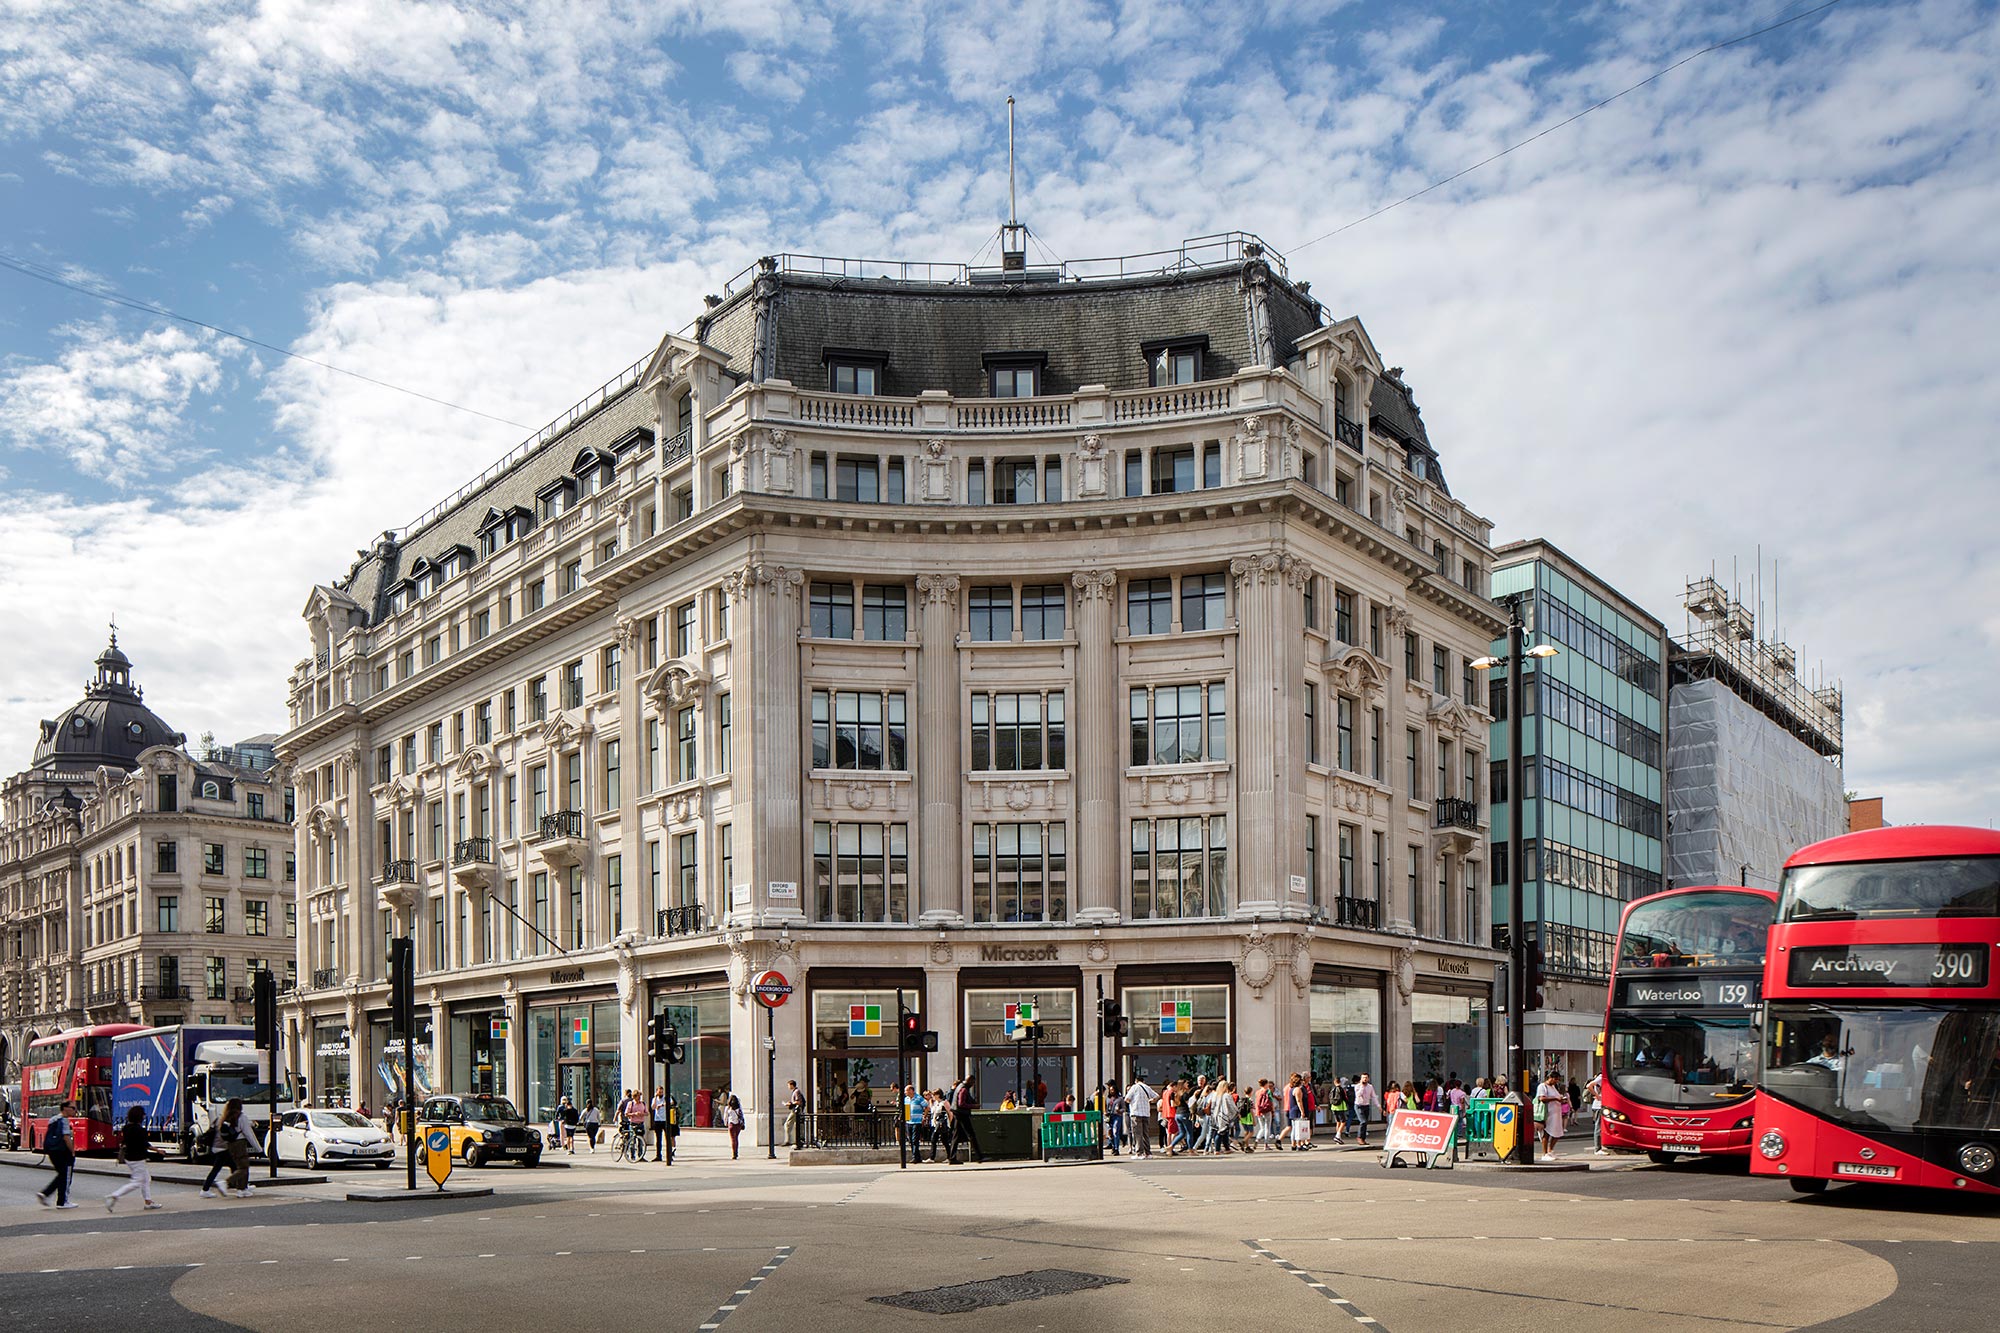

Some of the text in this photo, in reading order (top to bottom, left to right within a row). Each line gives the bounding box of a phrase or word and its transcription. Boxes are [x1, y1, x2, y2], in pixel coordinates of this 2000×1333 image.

[981, 945, 1058, 961] Microsoft
[1438, 958, 1470, 974] Microsoft
[1811, 952, 1973, 978] Archway 390
[550, 967, 585, 984] Microsoft
[756, 985, 792, 993] UNDERGROUND
[1636, 984, 1748, 1003] Waterloo 139
[118, 1052, 150, 1086] palletline
[1404, 1117, 1440, 1129] ROAD
[1395, 1131, 1441, 1145] CLOSED
[1866, 1166, 1889, 1176] 1763
